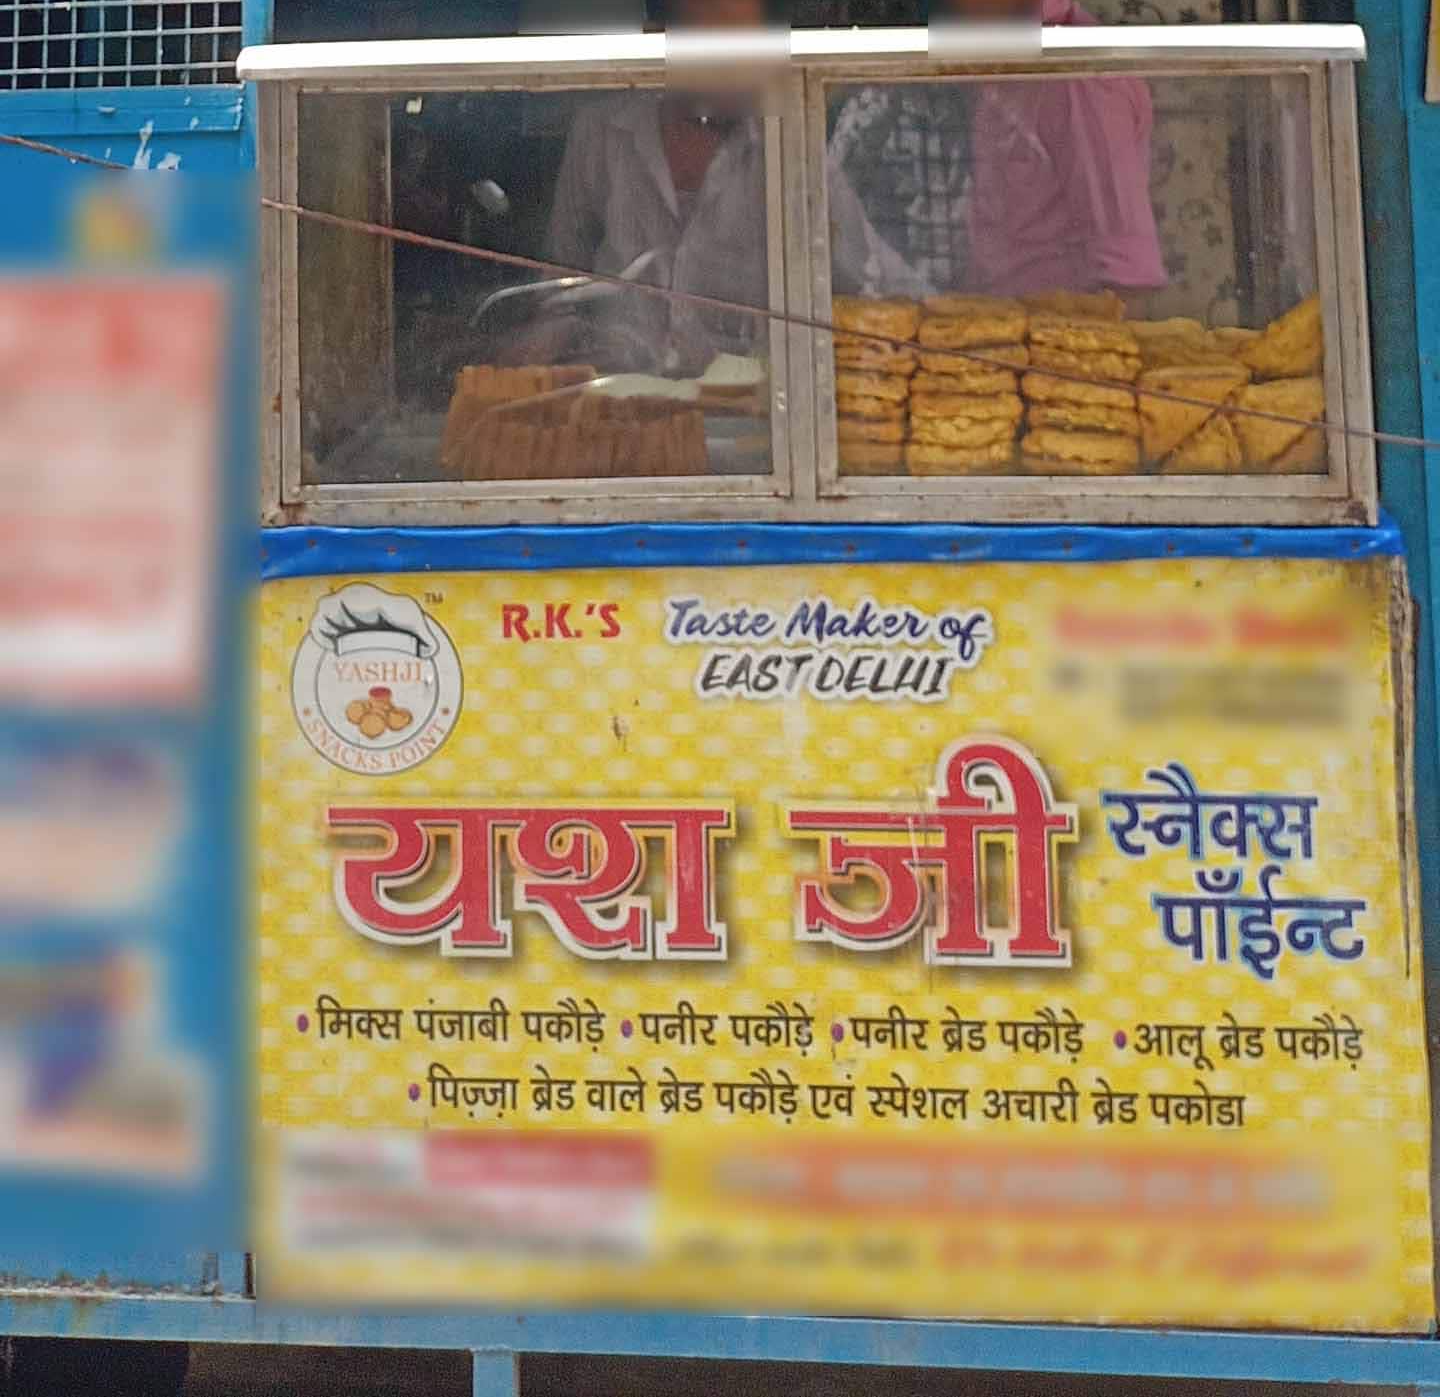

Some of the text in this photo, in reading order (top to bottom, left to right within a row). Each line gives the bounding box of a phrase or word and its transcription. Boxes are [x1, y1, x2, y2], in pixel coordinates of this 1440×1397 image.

[669, 599, 988, 664] Taste Maker of
[333, 660, 424, 686] YASHJI
[701, 654, 954, 697] EAST DELHI
[306, 719, 449, 771] SNACKS POINT
[1100, 763, 1318, 860] स्नैक्स
[327, 803, 733, 958] यश
[787, 738, 1076, 962] जी
[316, 994, 1363, 1070] मिक्स पंजाबी पकौड़े पनीर पकौड़े पनीर ब्रेड पकौड़े आलू ब्रेड पकौड़े
[530, 1064, 577, 1111] ब्रेड
[585, 1067, 646, 1113] वाले
[658, 1067, 704, 1113] ब्रेड
[713, 1068, 799, 1124] पकौड़े
[808, 1073, 856, 1120] एवं
[866, 1072, 969, 1120] स्पेशल
[982, 1077, 1079, 1122] अचारी
[1091, 1078, 1139, 1125] ब्रेड
